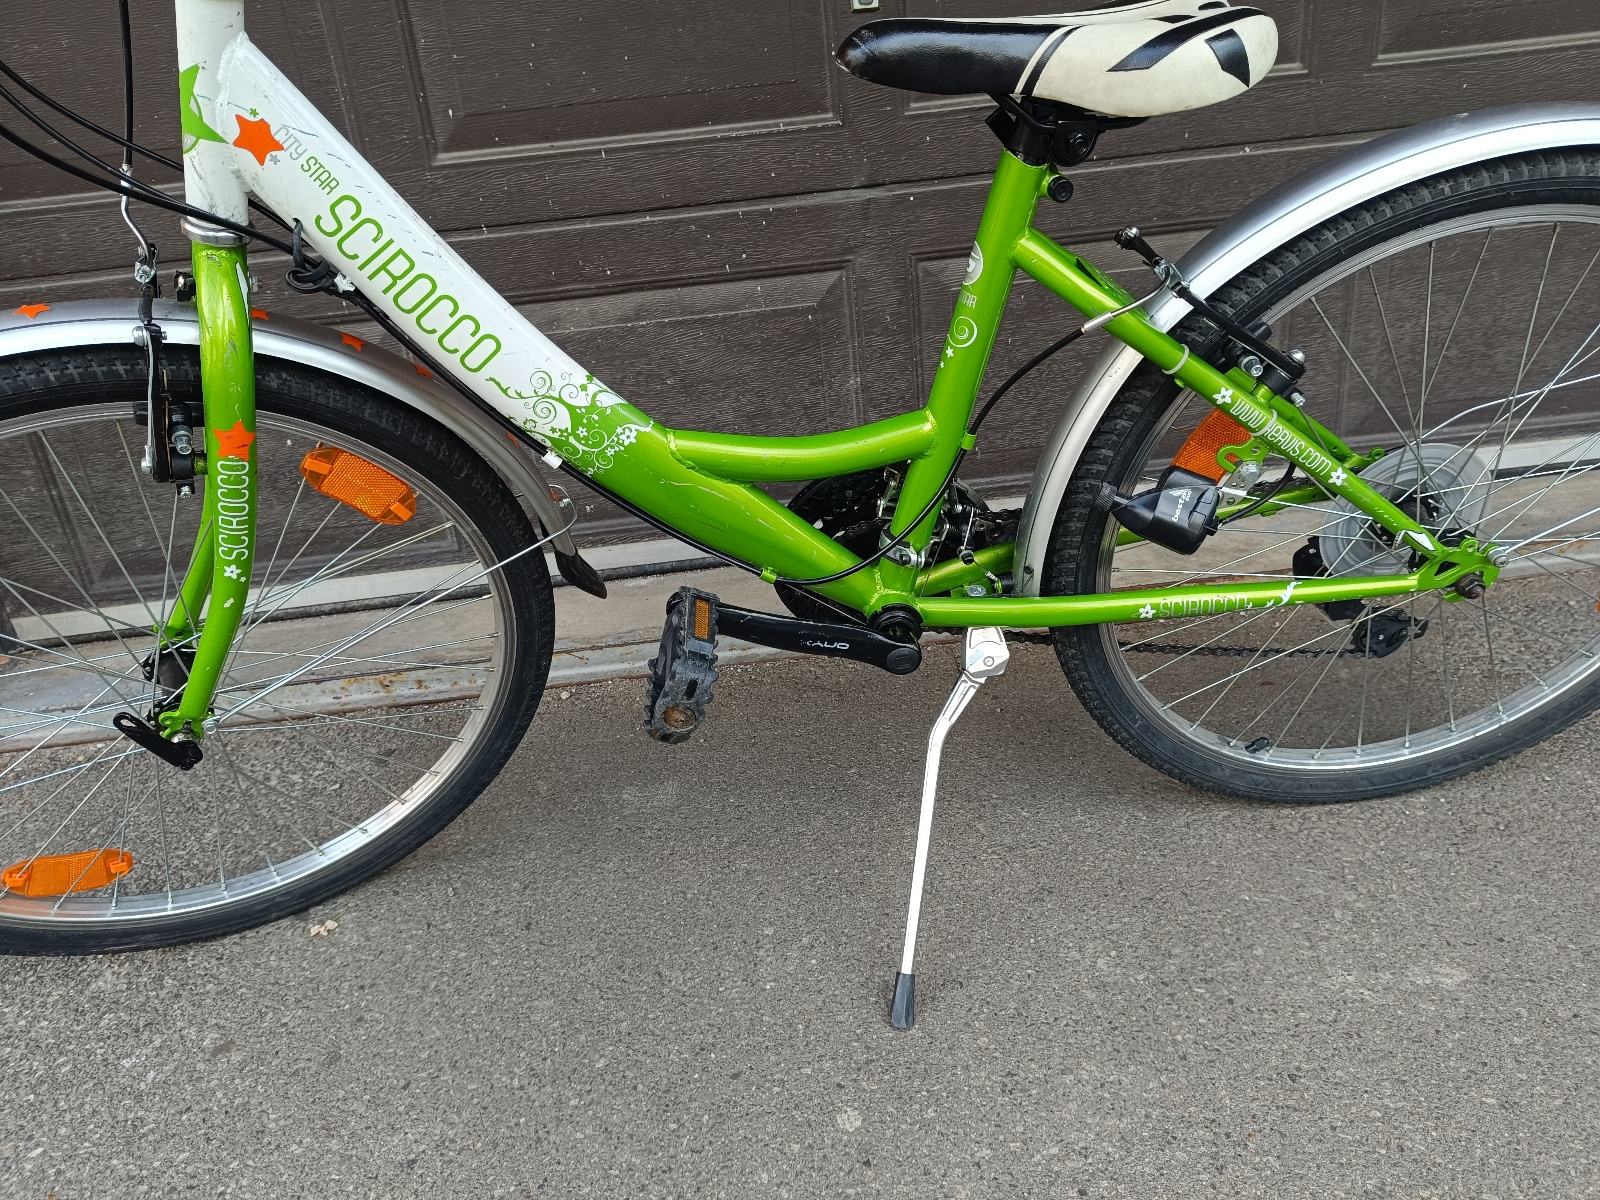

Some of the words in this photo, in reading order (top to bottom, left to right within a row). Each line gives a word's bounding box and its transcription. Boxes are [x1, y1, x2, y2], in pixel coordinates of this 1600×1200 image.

[300, 156, 339, 195] STAR
[314, 194, 502, 373] SCIROCCO
[217, 460, 249, 560] SCIROCCO
[1160, 594, 1248, 617] SCIROCCO
